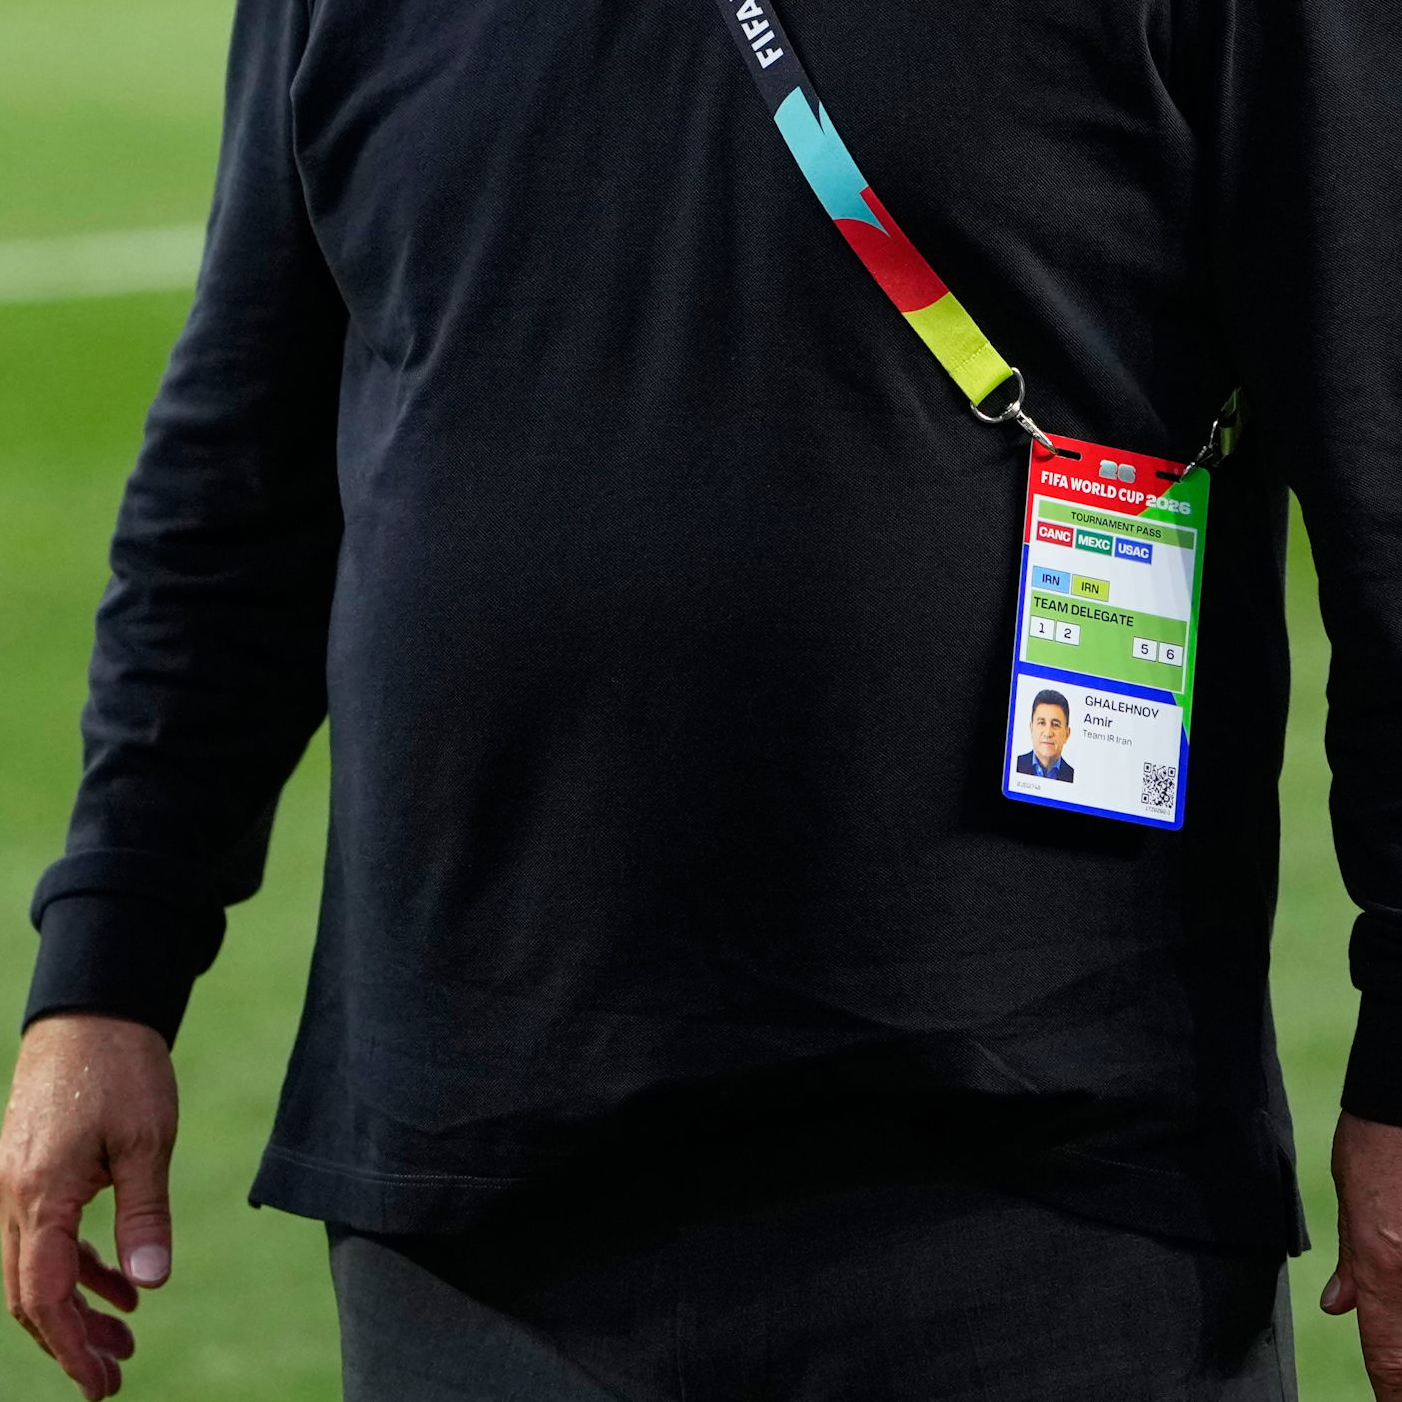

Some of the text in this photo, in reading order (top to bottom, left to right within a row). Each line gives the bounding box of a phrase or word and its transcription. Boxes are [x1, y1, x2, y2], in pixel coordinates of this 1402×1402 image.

[1041, 470, 1191, 515] FIFA WORLD CUP 2026
[1071, 512, 1162, 539] TOURNAMENT PASS
[1039, 527, 1071, 543] CANC
[1078, 534, 1111, 551] MEXC
[1118, 543, 1149, 559] USAC
[1042, 574, 1060, 586] IRN
[1081, 582, 1099, 594] IRN
[1034, 596, 1134, 627] TEAM DELEGATE
[1039, 622, 1045, 634] 1
[1064, 628, 1072, 639] 2
[1141, 644, 1149, 655] 5
[1166, 649, 1175, 660] 6
[1085, 695, 1159, 718] GHALEHNOV
[1083, 713, 1113, 728] Amir
[1083, 729, 1106, 742] Team
[1116, 735, 1132, 746] Iran
